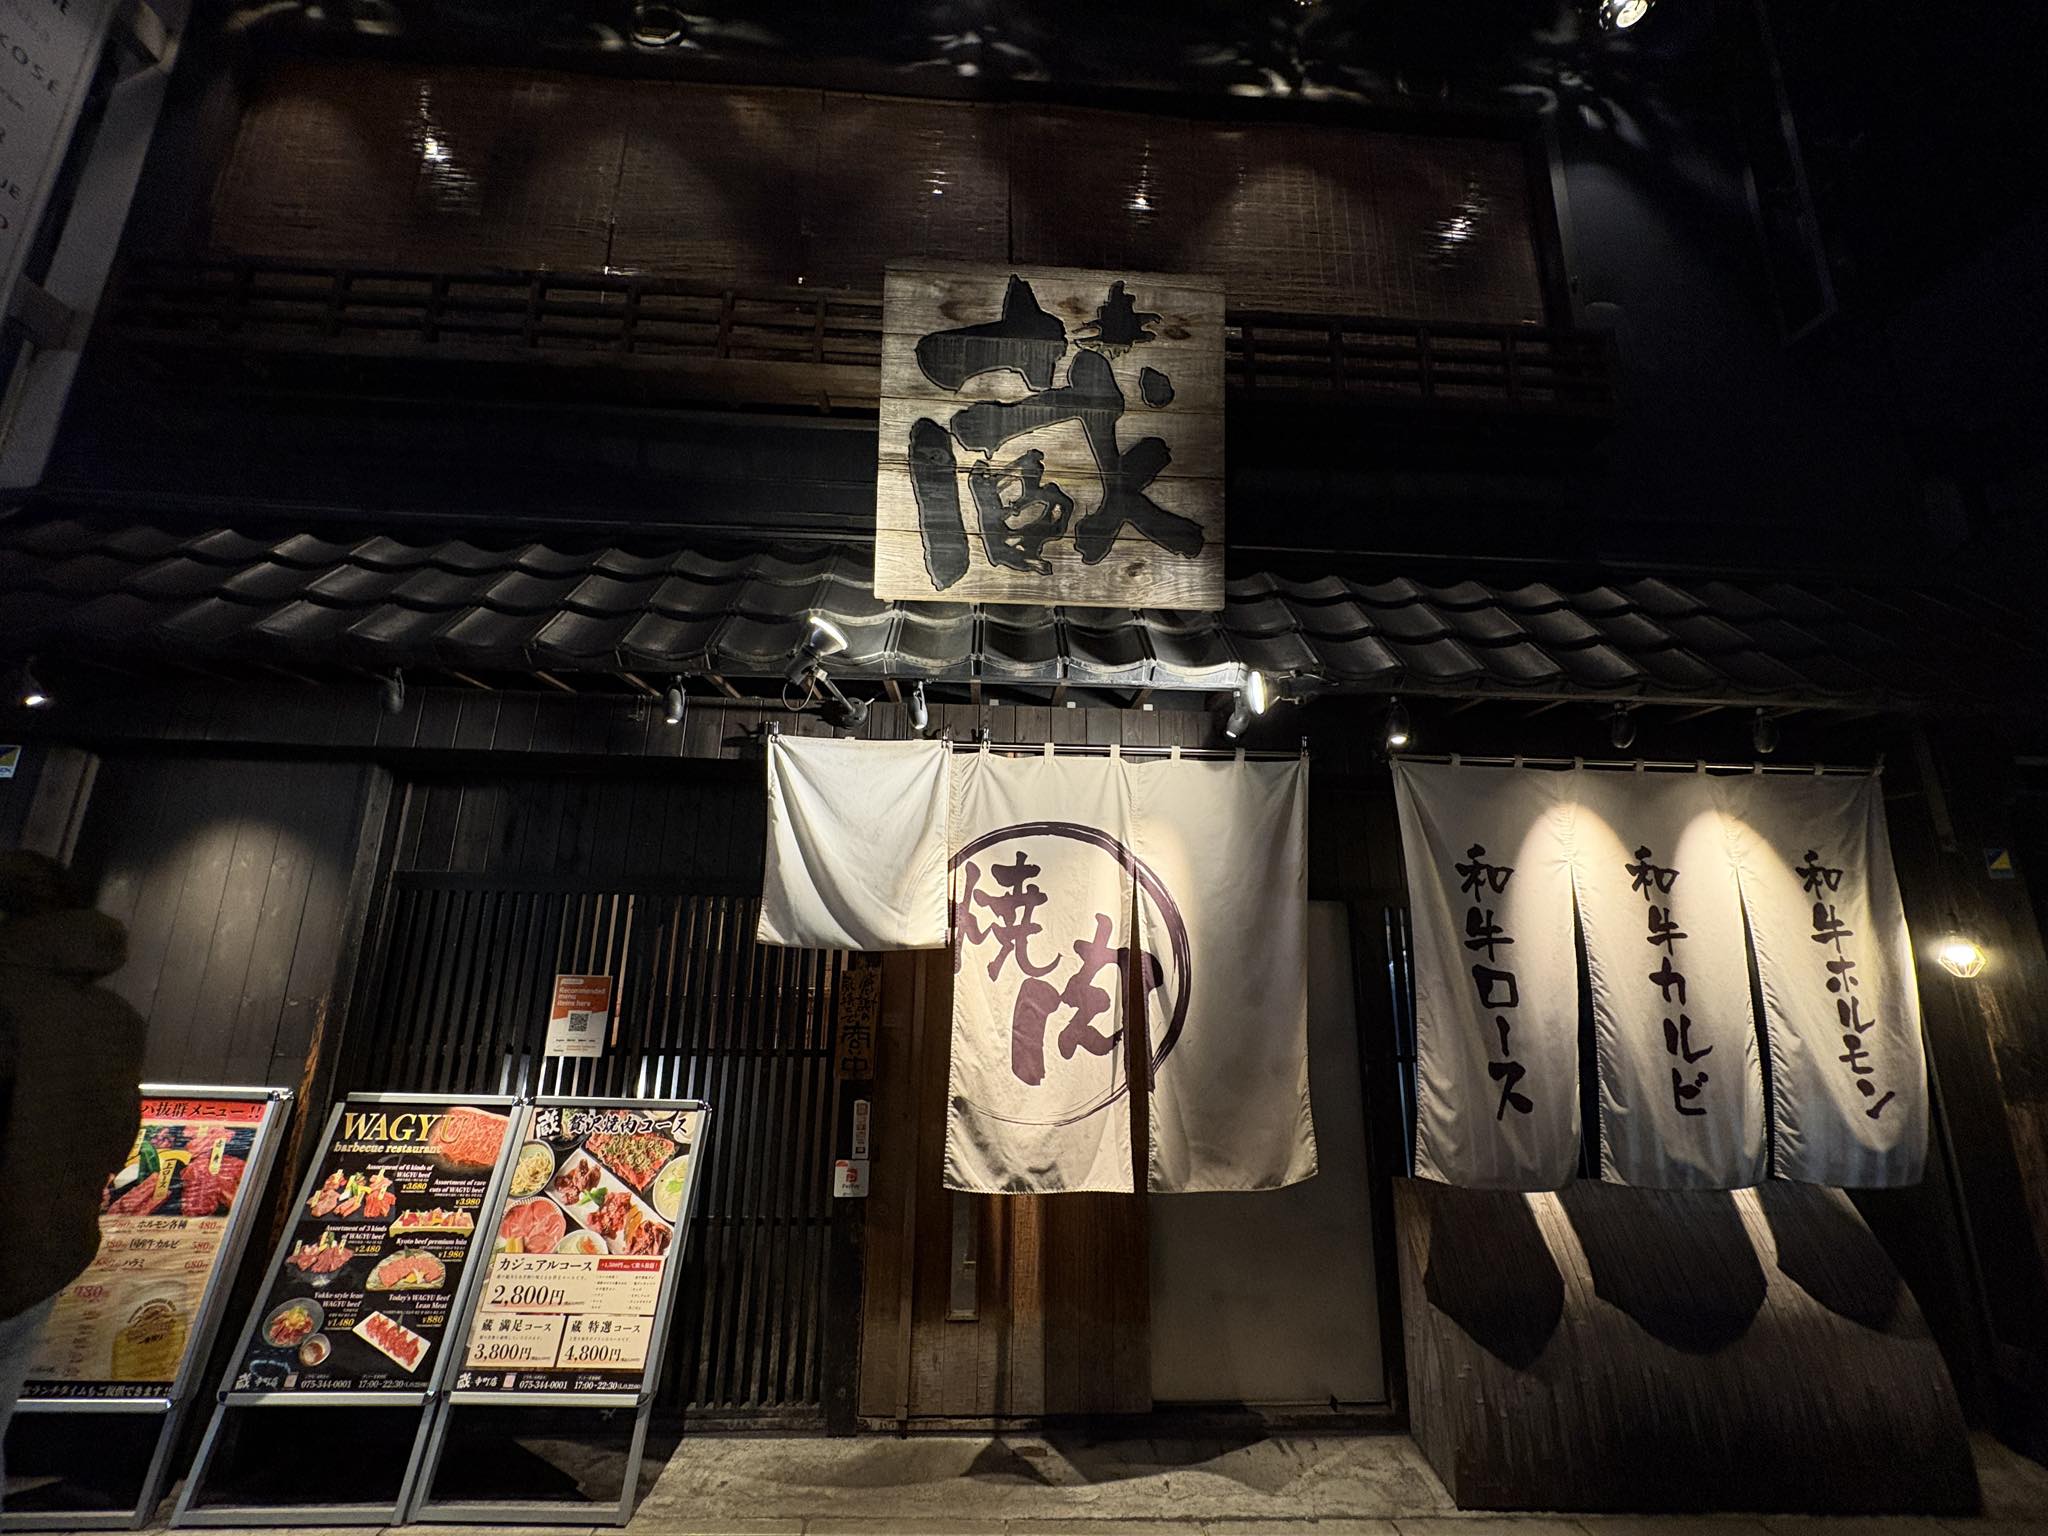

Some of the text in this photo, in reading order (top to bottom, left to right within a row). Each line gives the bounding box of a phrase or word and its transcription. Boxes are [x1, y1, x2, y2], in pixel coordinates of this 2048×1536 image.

[909, 274, 1204, 590] 蔵
[952, 851, 1164, 1086] 焼肉
[1455, 844, 1533, 1120] 和牛ロース
[1625, 845, 1712, 1116] 和牛カルビ
[1795, 850, 1895, 1119] 和牛ホルモン
[343, 1112, 467, 1143] WAGYU
[536, 1108, 688, 1138] 蔵 贅沢焼肉コース
[334, 1141, 442, 1154] barbecue restaurant
[396, 1238, 414, 1246] Kyoto
[427, 1238, 454, 1246] premium
[497, 1258, 592, 1272] カジュアルコース
[389, 1294, 411, 1302] Today's
[490, 1284, 565, 1307] 2,800円
[481, 1318, 551, 1332] 蔵 満足コース
[571, 1320, 641, 1333] 蔵 特選コース
[474, 1343, 532, 1361] 3,800円
[564, 1344, 621, 1362] 4,800円
[301, 1379, 352, 1389] 075-344-0001
[456, 1372, 472, 1389] 蔵
[519, 1380, 568, 1389] 075-344-0001
